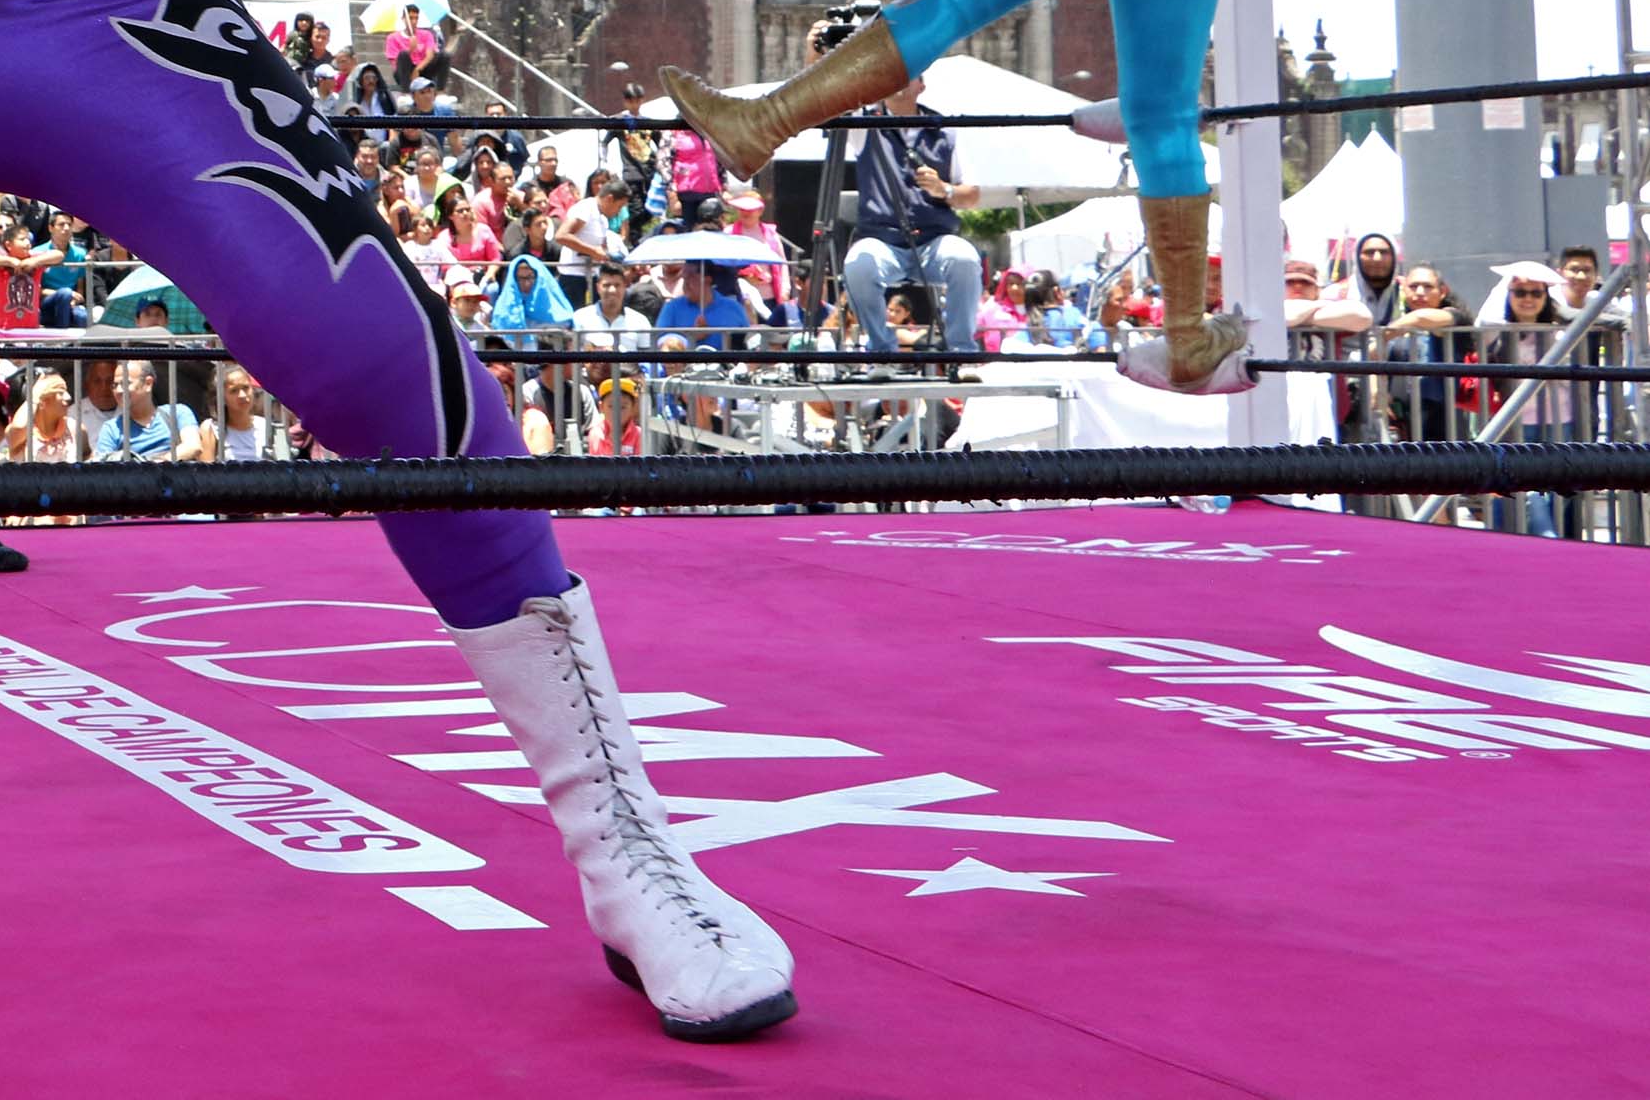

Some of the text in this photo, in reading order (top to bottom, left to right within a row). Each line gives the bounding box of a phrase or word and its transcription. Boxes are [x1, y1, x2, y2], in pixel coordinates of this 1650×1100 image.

[867, 530, 1311, 558] CDMX
[3, 685, 133, 711] DE
[982, 636, 1650, 750] FIRE
[1115, 696, 1450, 762] SPORTS
[57, 713, 422, 853] CAMPEONES
